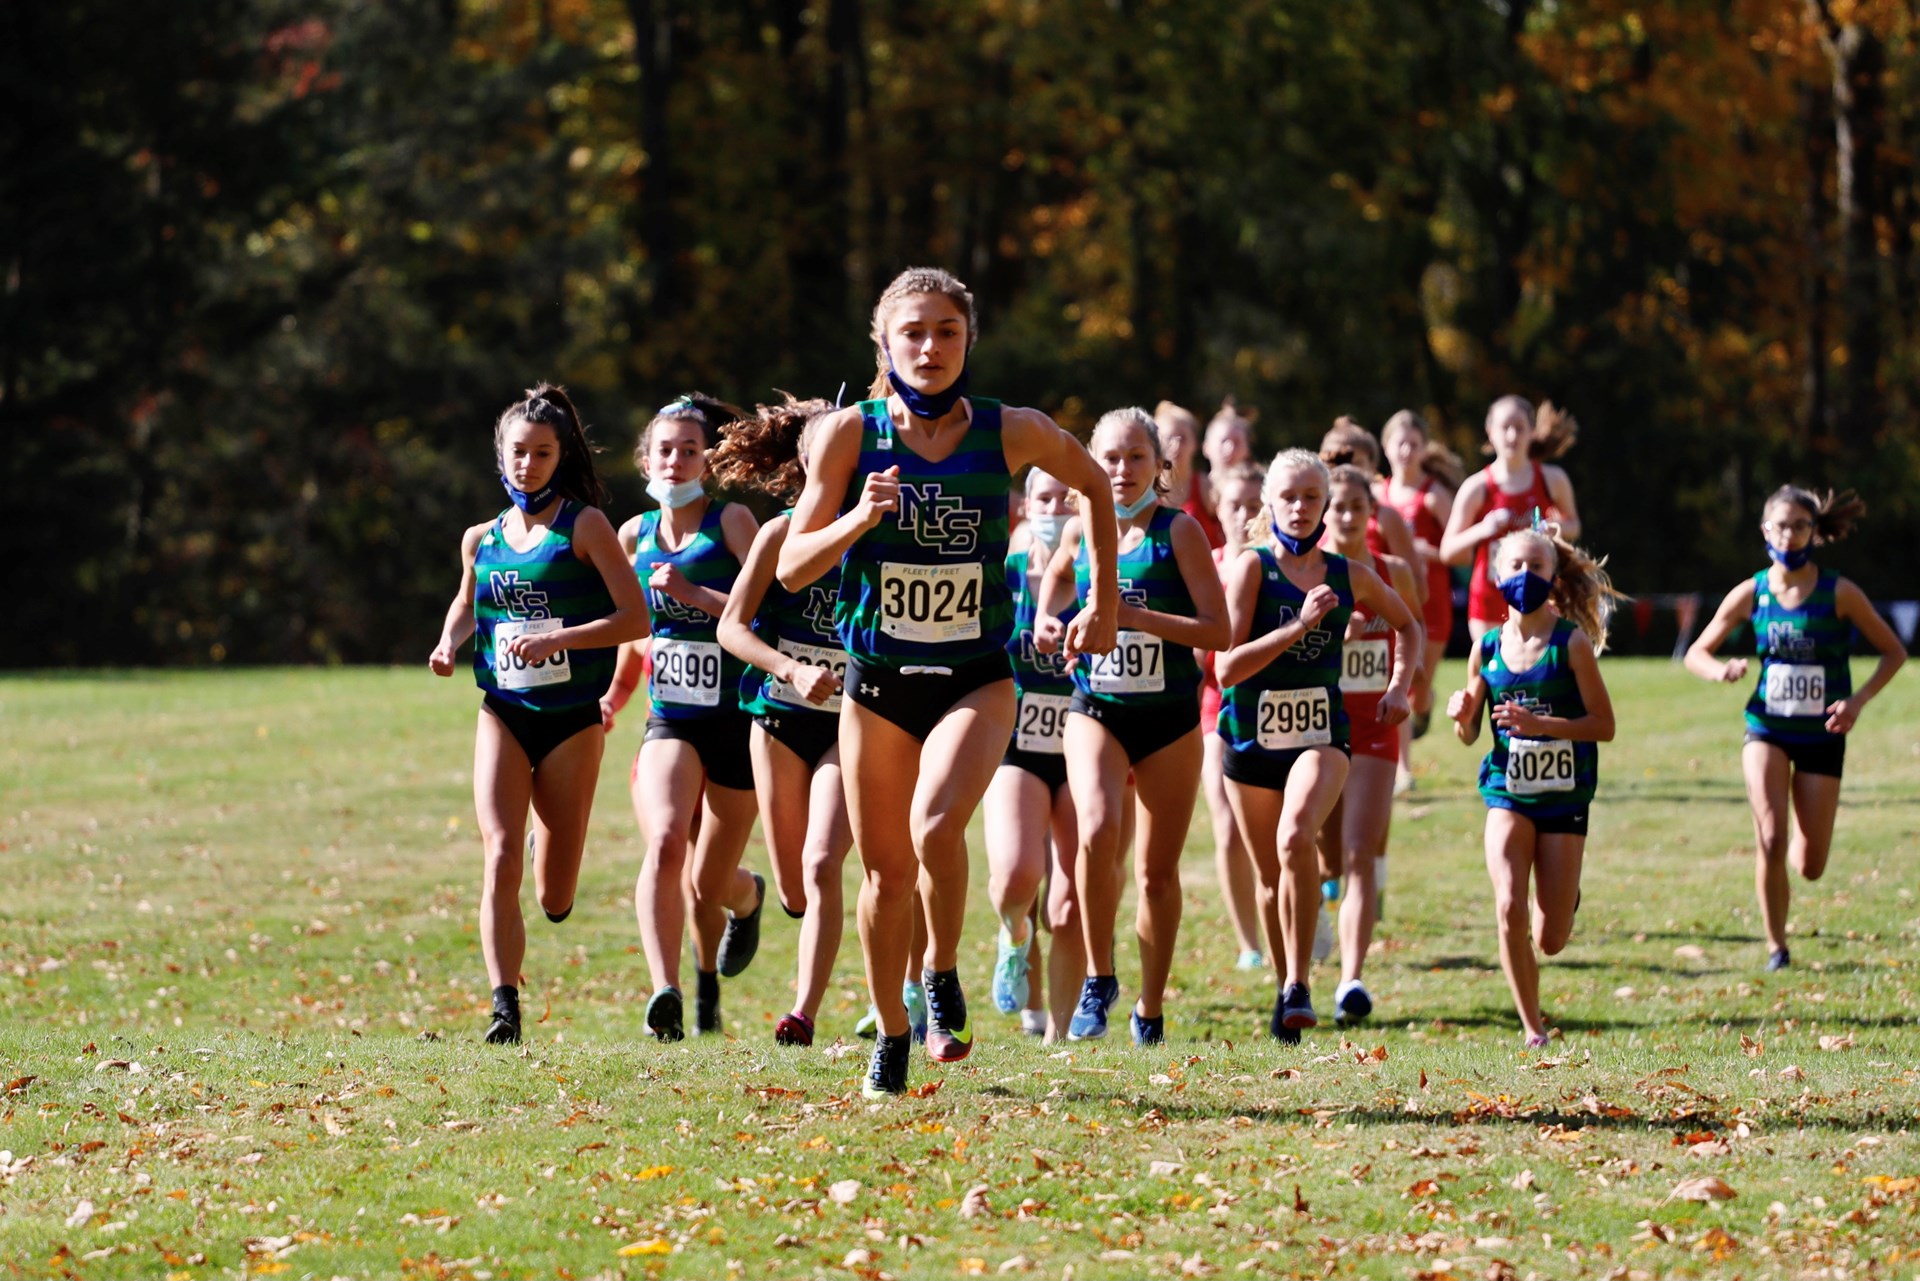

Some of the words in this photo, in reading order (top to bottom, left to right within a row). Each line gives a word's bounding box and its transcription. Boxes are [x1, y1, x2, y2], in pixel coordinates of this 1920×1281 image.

[898, 483, 981, 555] NCS
[902, 567, 928, 576] FLEET
[939, 567, 960, 576] FEET
[490, 570, 551, 622] NCS
[884, 577, 978, 622] 3024
[656, 650, 718, 688] 2999
[1094, 643, 1160, 677] 2997
[1347, 650, 1387, 679] 084
[1021, 704, 1069, 739] 299
[1260, 698, 1327, 733] 2995
[1508, 749, 1572, 782] 3026
